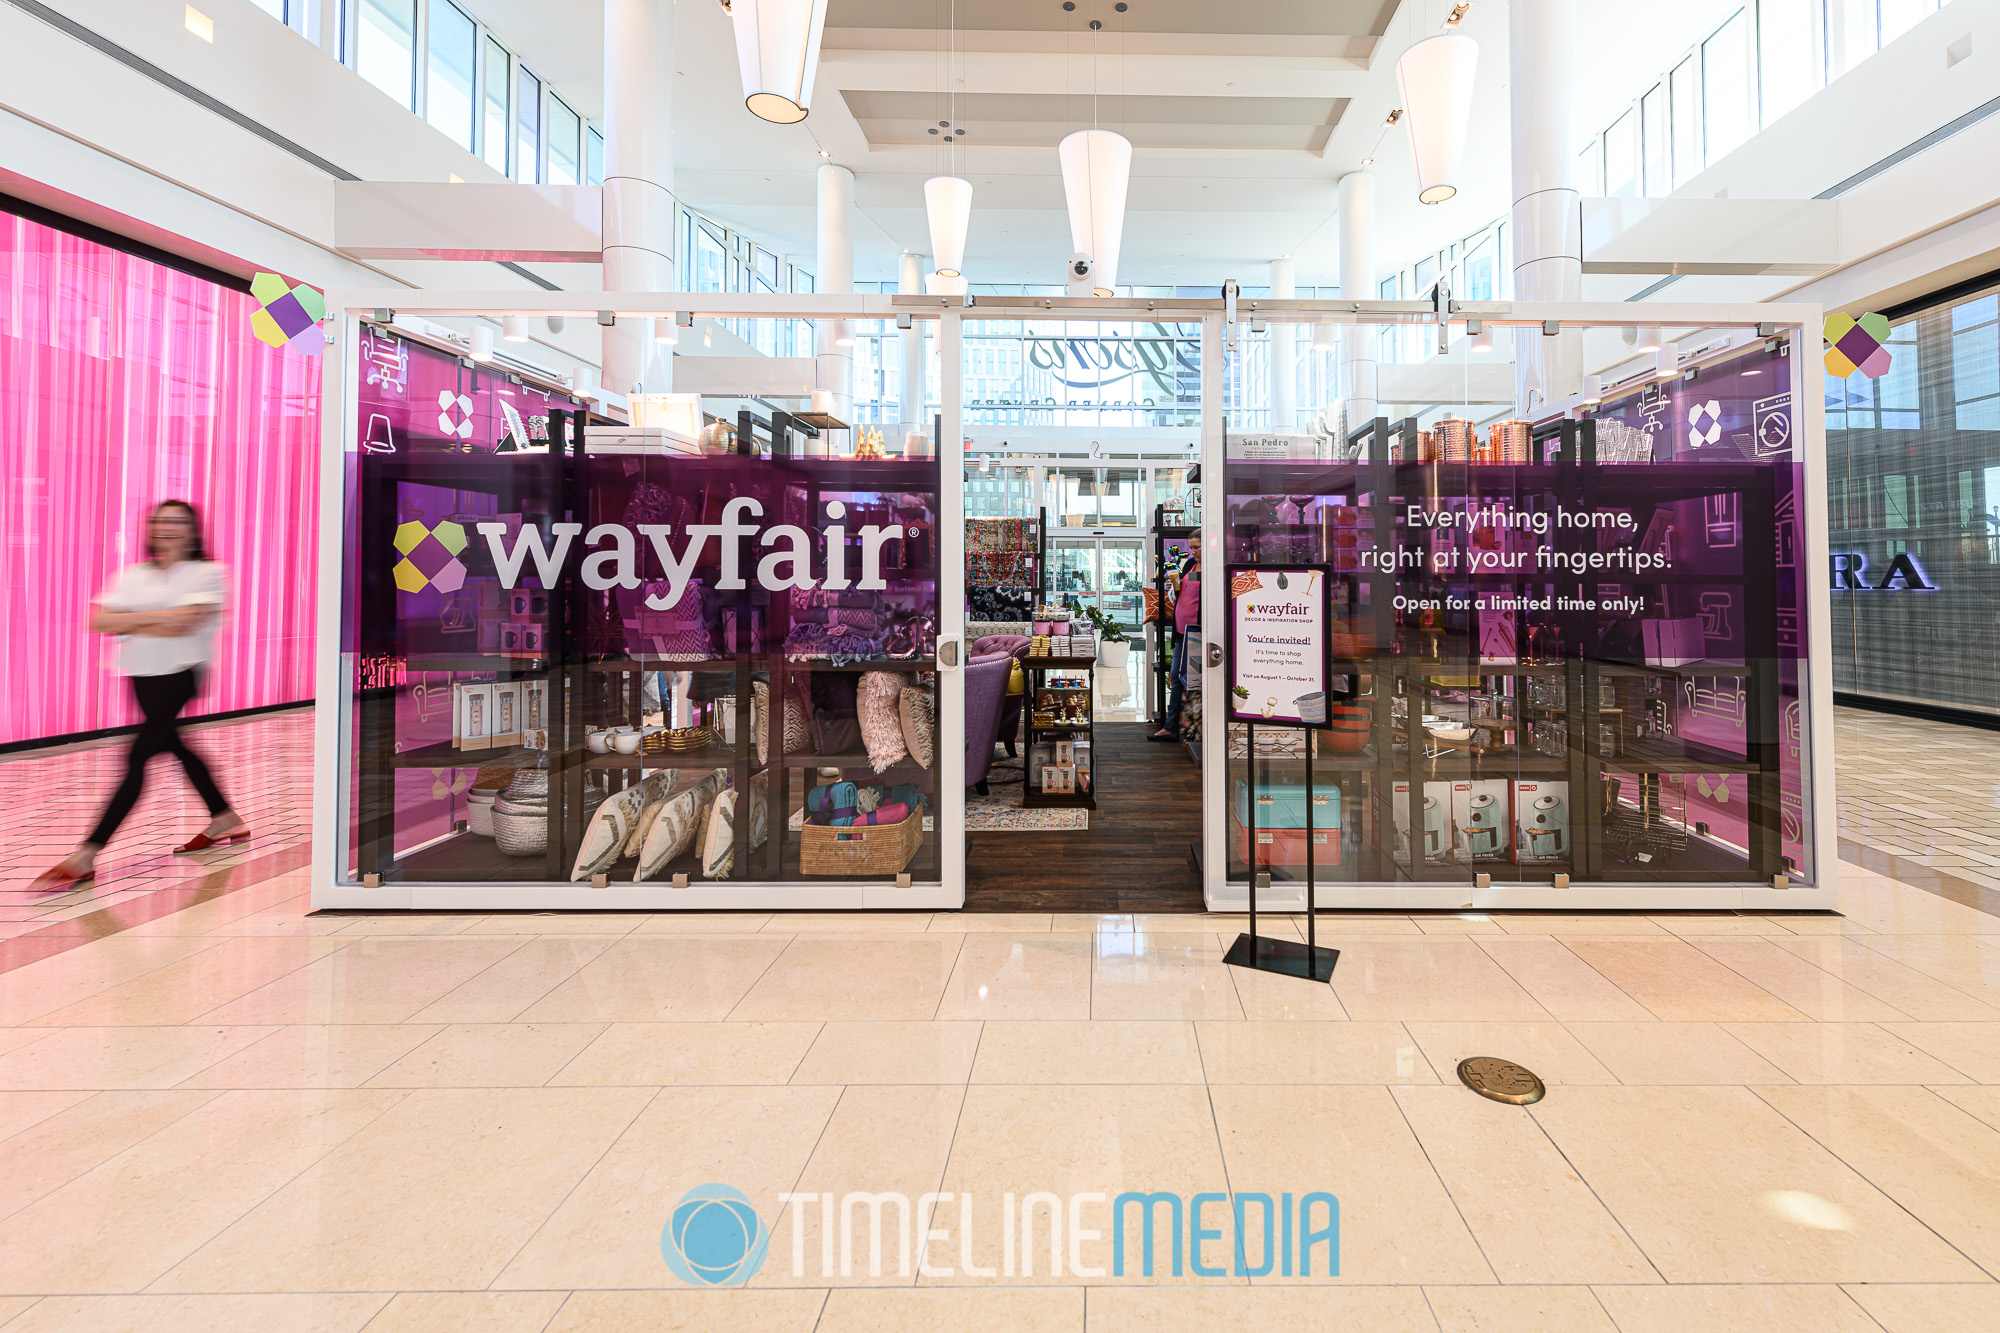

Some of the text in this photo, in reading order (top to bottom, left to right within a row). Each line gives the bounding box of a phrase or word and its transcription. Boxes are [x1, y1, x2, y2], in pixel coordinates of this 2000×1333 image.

[1242, 438, 1289, 447] San Pedro
[1407, 505, 1639, 534] Everything home,
[476, 496, 904, 611] wayfair
[1360, 544, 1673, 574] right at your fingertips.
[1256, 602, 1310, 617] wayfair
[1392, 595, 1645, 614] Open for a limited time only!
[1247, 634, 1311, 645] You're invited!
[1253, 658, 1285, 666] everything
